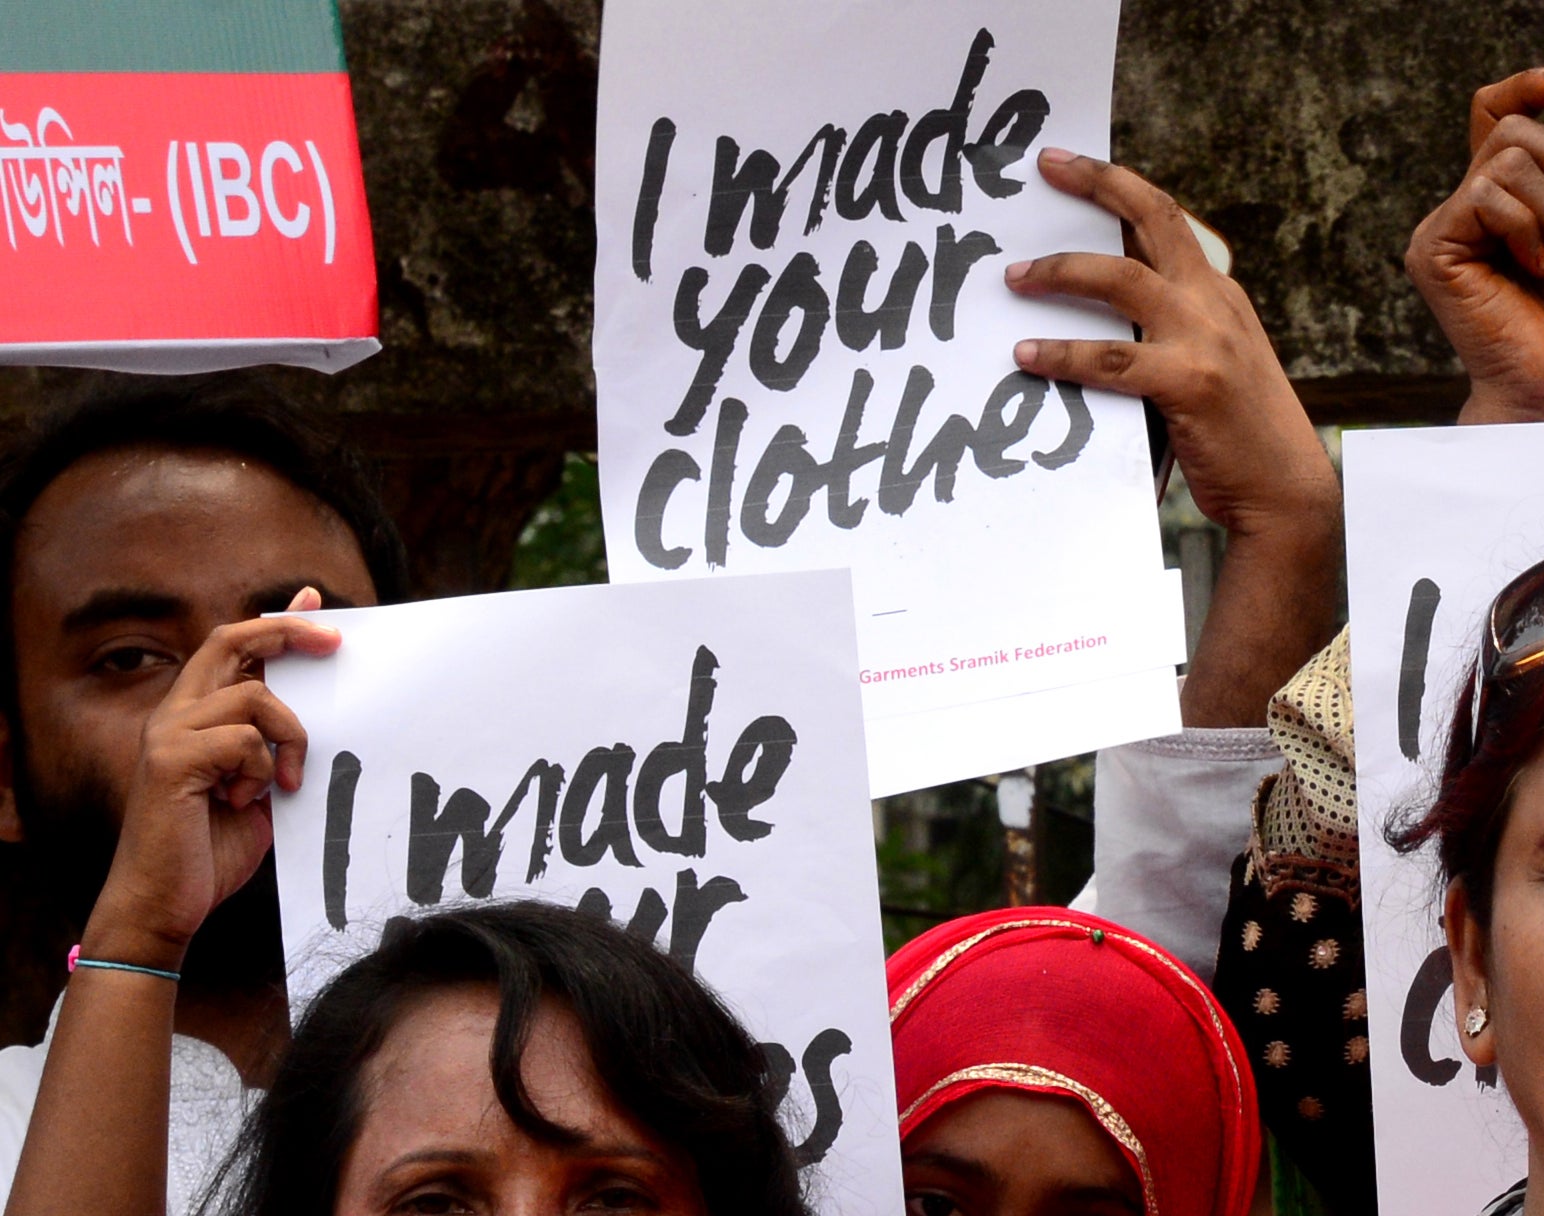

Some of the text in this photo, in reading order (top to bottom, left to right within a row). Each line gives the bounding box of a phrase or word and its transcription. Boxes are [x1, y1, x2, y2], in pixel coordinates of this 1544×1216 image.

[167, 140, 336, 265] (IBC)
[632, 27, 1051, 284] I made
[664, 223, 1002, 437] your
[634, 365, 1095, 571] clothes
[859, 635, 1107, 684] Garments Sramik Federation
[1398, 577, 1441, 763] I
[322, 750, 362, 933] I
[406, 644, 797, 906] made
